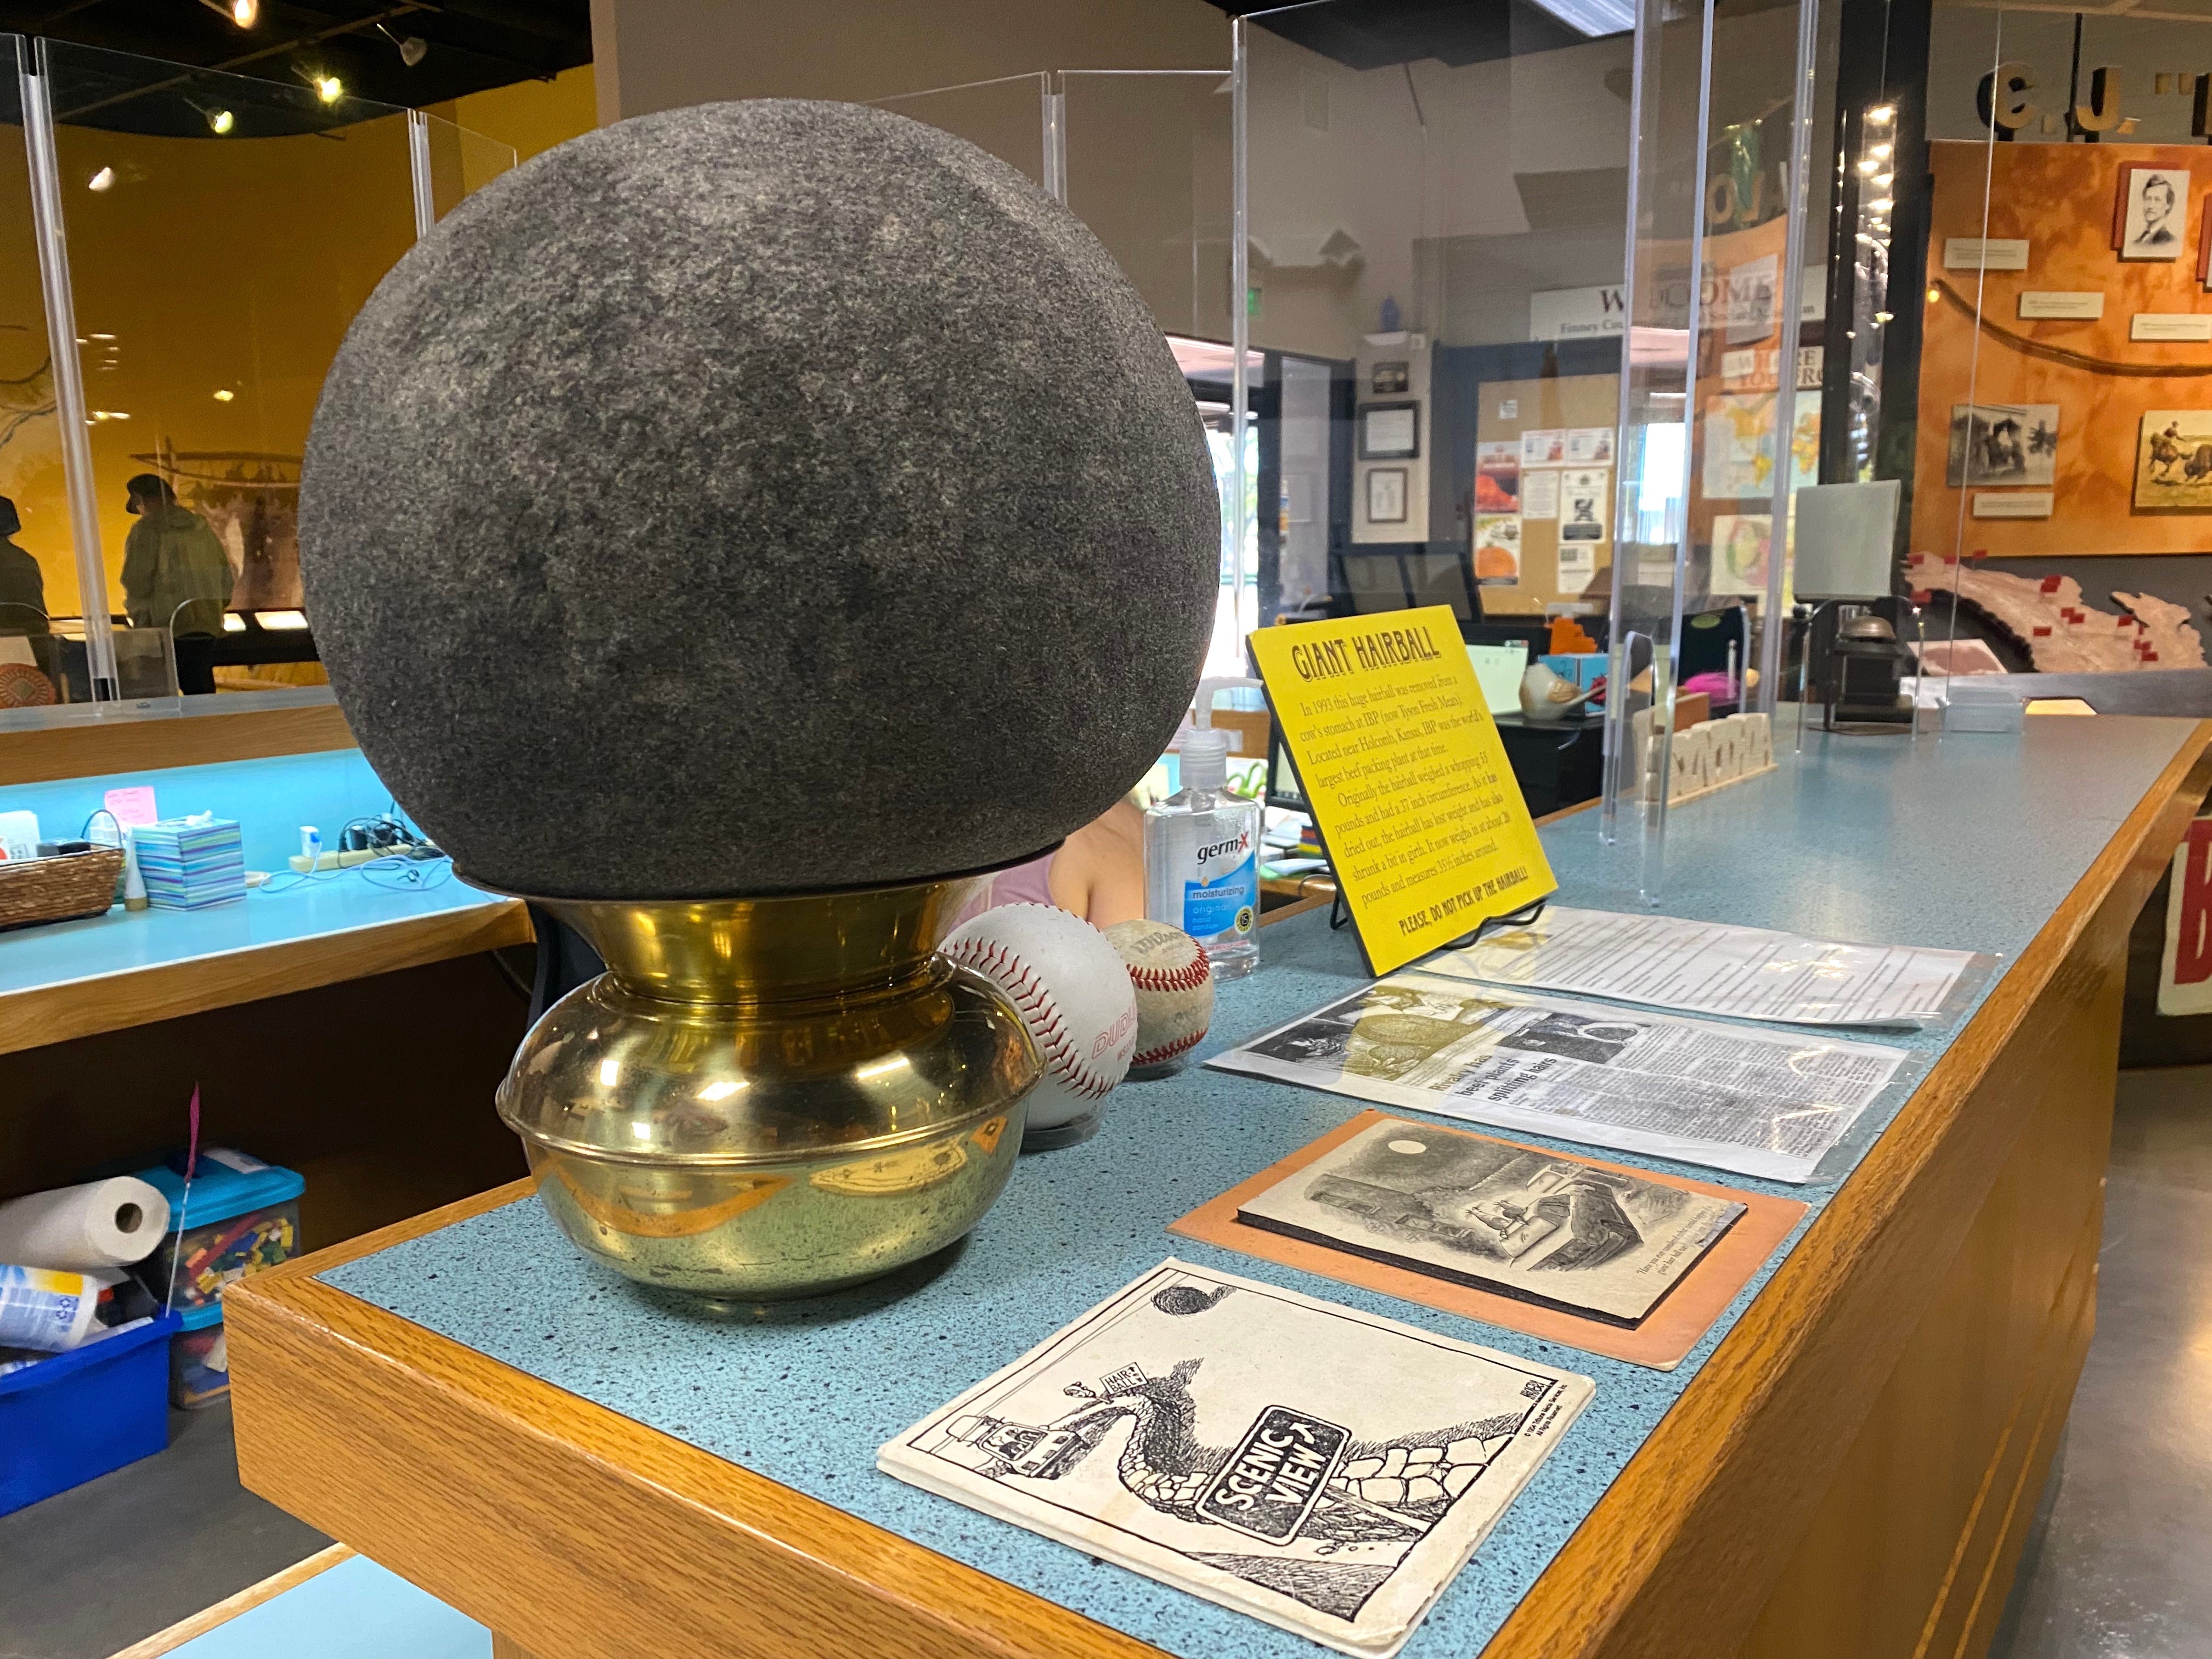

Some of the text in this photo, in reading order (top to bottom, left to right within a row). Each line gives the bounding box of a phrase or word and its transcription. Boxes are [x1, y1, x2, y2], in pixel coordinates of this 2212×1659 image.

[1292, 627, 1441, 682] GIANT HAIRBALL
[1300, 703, 1312, 716] In
[1312, 698, 1333, 713] 1993
[1334, 695, 1348, 709] this
[1347, 693, 1368, 708] huge
[1367, 684, 1395, 701] hairball
[1395, 686, 1408, 695] was
[1409, 676, 1437, 692] removed
[1300, 724, 1323, 741] cow's
[1323, 716, 1355, 736] stomach
[1356, 718, 1364, 727] at
[1362, 711, 1378, 725] IBP
[1380, 710, 1398, 724] (now
[1397, 704, 1420, 720] Tyson
[1418, 698, 1438, 713] Fresh
[1306, 743, 1341, 764] Located
[1342, 744, 1358, 755] near
[1358, 731, 1397, 751] Holcomb,
[1421, 720, 1436, 734] IBP
[1438, 721, 1451, 730] was
[1450, 715, 1461, 727] the
[1315, 743, 1448, 789] largest beef packing plant at that time.
[1338, 784, 1377, 806] Originally
[1378, 781, 1391, 795] the
[1389, 771, 1418, 791] hairball
[1417, 763, 1444, 783] weighed
[1444, 766, 1450, 774] a
[1449, 755, 1481, 772] whopping
[1335, 813, 1364, 839] pounds
[1364, 807, 1379, 824] and
[1378, 802, 1395, 819] had
[1395, 806, 1401, 814] a
[1400, 799, 1409, 812] 37
[1409, 793, 1426, 809] inch
[1472, 776, 1481, 788] As
[1485, 772, 1497, 783] has
[1344, 837, 1365, 857] dried
[1366, 837, 1382, 849] out,
[1381, 829, 1394, 843] the
[1392, 818, 1421, 839] hairball
[1420, 816, 1434, 829] has
[1432, 812, 1446, 825] lost
[1446, 804, 1468, 820] weight
[1468, 798, 1480, 812] and
[1479, 796, 1491, 808] has
[1352, 859, 1380, 881] shrunk
[1381, 861, 1386, 870] a
[1385, 853, 1398, 867] bit
[1396, 850, 1407, 863] in
[1425, 839, 1435, 852] It
[1435, 837, 1448, 849] now
[1449, 826, 1471, 843] weighs
[1470, 823, 1479, 835] in
[1479, 822, 1487, 832] at
[1486, 816, 1503, 830] about
[1193, 886, 1244, 900] moisturizing
[1361, 882, 1390, 909] pounds
[1391, 874, 1406, 892] and
[1406, 866, 1437, 886] measures
[1452, 850, 1474, 866] inches
[1399, 866, 1528, 935] PLEASE, DO NOT PICK UP THE HAIRBALL!
[1428, 1055, 1492, 1091] Rivalry has
[1454, 1058, 1519, 1096] beef plants
[1488, 1058, 1557, 1101] splitting hairs
[1105, 1370, 1131, 1385] HAIR-
[1110, 1379, 1136, 1392] BALL
[1215, 1428, 1294, 1510] SCENIC
[1265, 1443, 1326, 1504] VIEW
